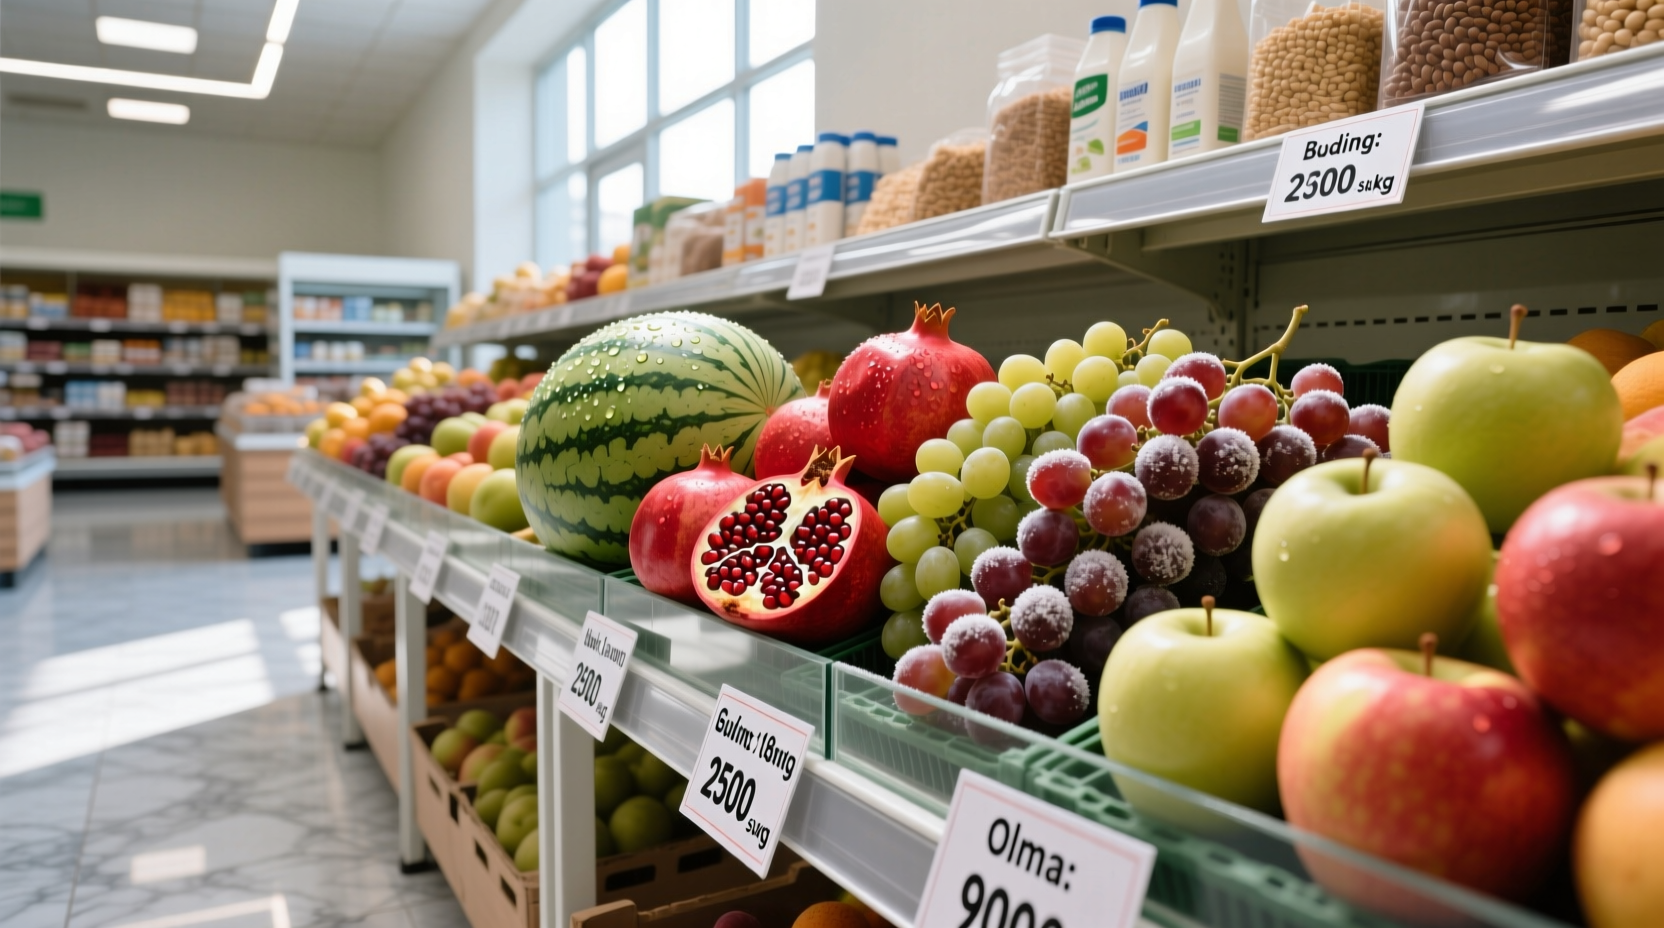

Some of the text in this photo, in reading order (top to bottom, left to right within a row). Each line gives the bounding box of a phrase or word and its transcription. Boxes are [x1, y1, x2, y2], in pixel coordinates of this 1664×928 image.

[1303, 132, 1382, 160] Buding:
[700, 756, 756, 822] 2500
[988, 818, 1075, 890] Olma:
[958, 874, 1063, 928] 90
